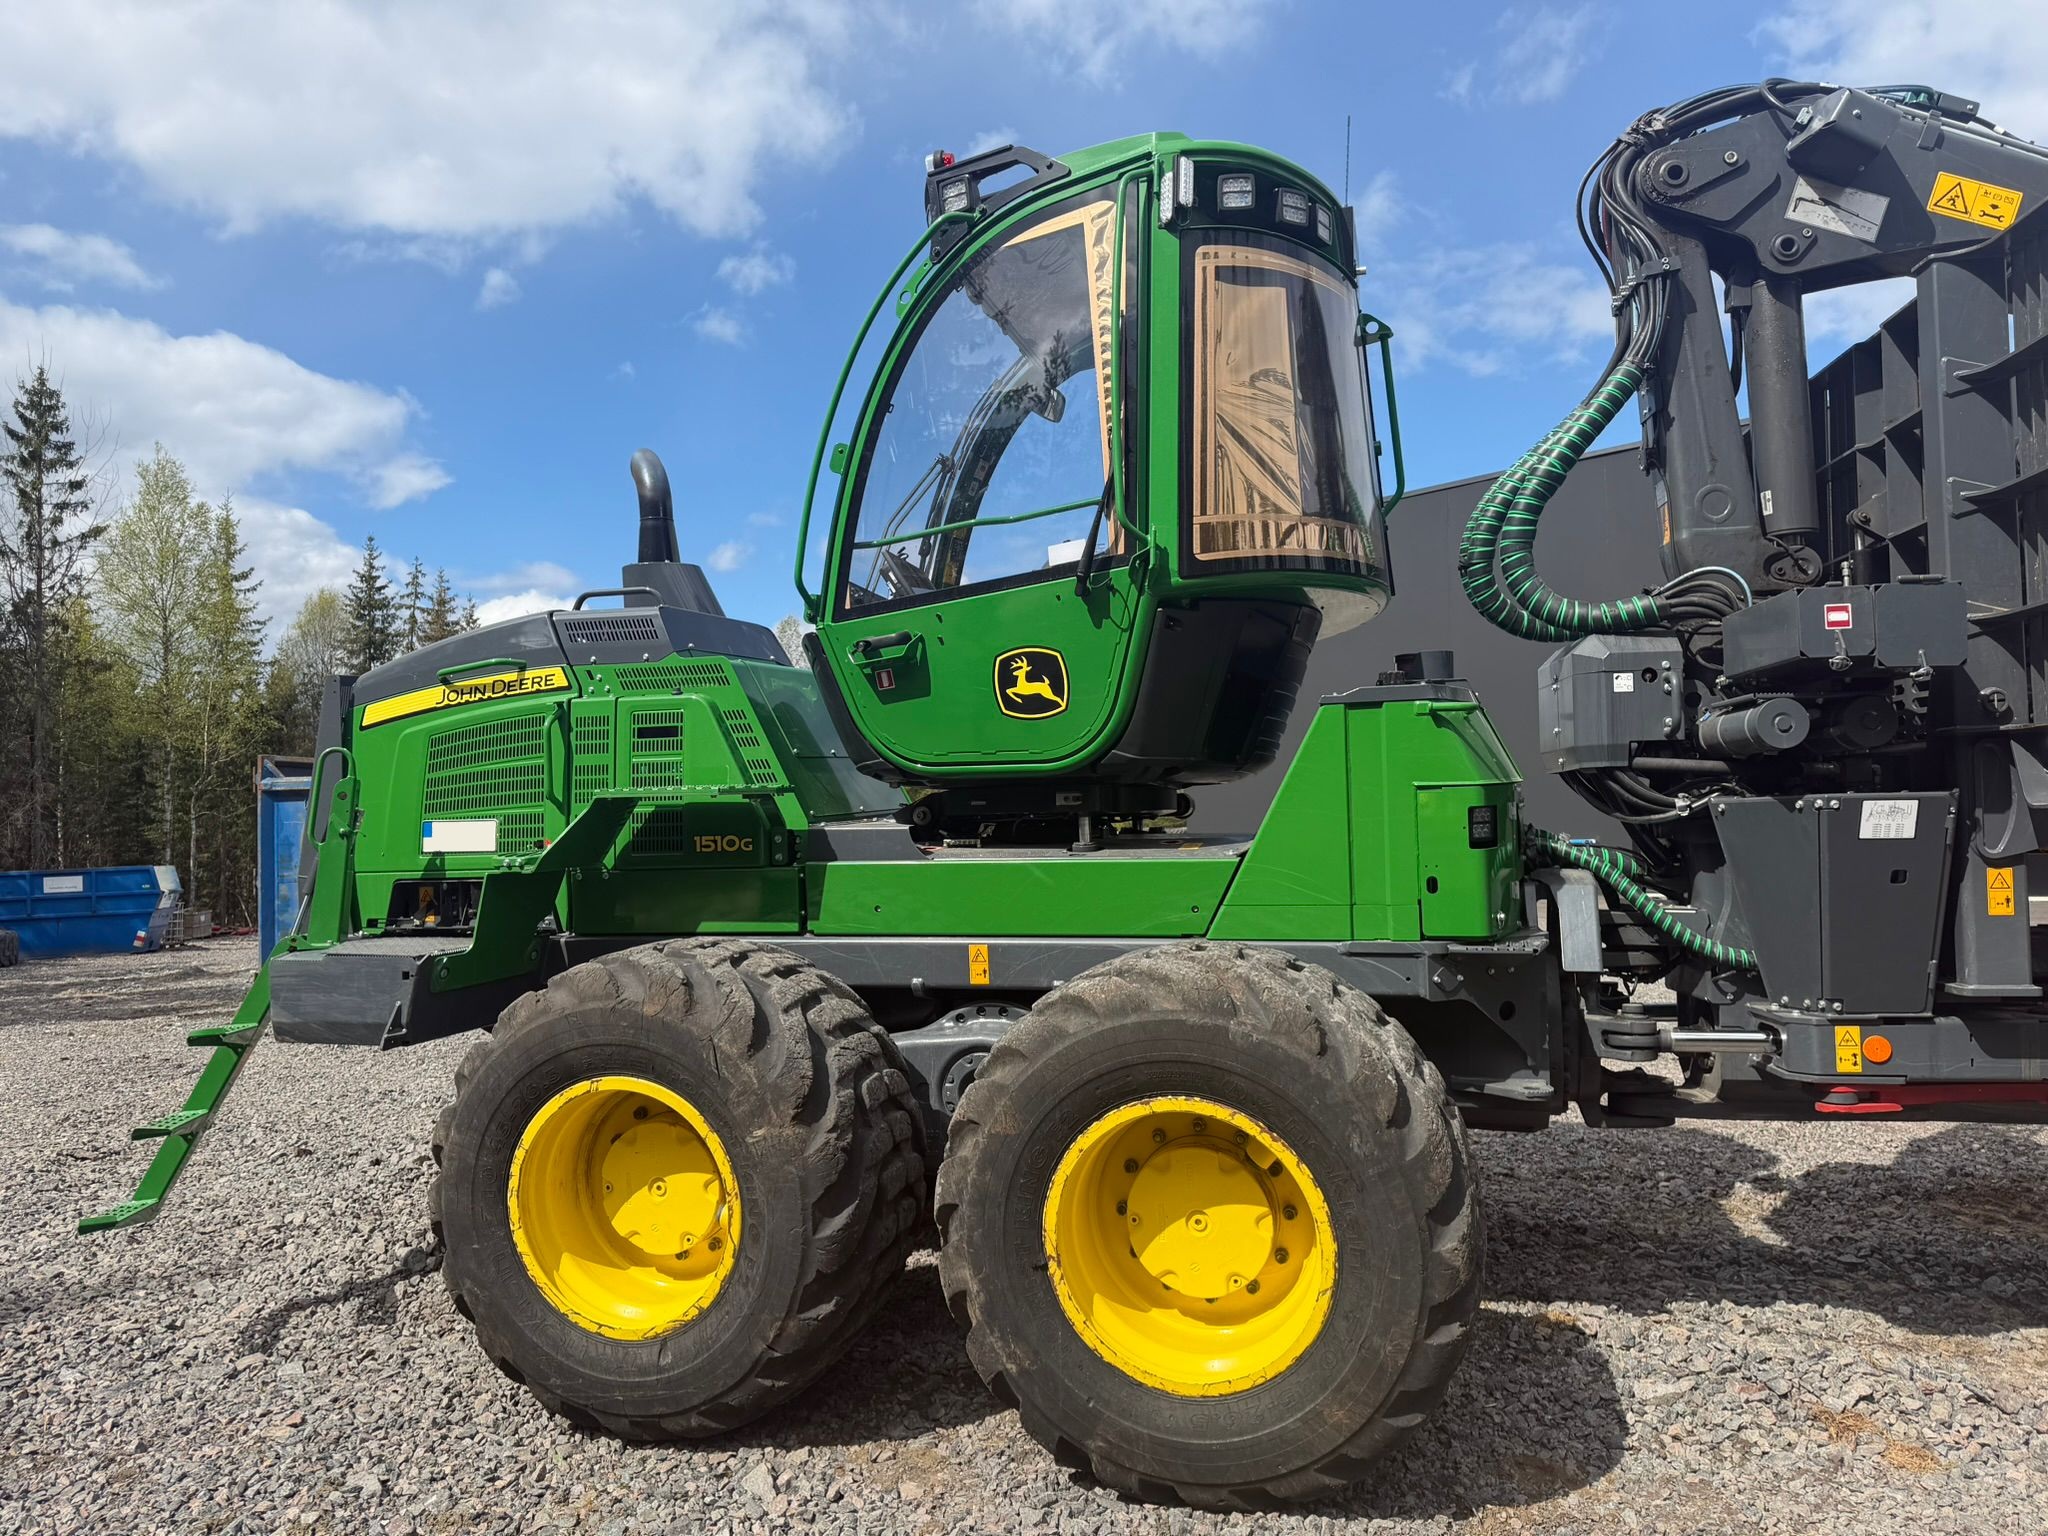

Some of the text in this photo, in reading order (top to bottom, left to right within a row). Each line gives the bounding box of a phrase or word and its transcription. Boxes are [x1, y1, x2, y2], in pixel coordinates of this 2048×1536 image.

[436, 673, 556, 705] JOHN DEERE
[693, 834, 753, 852] 1510G
